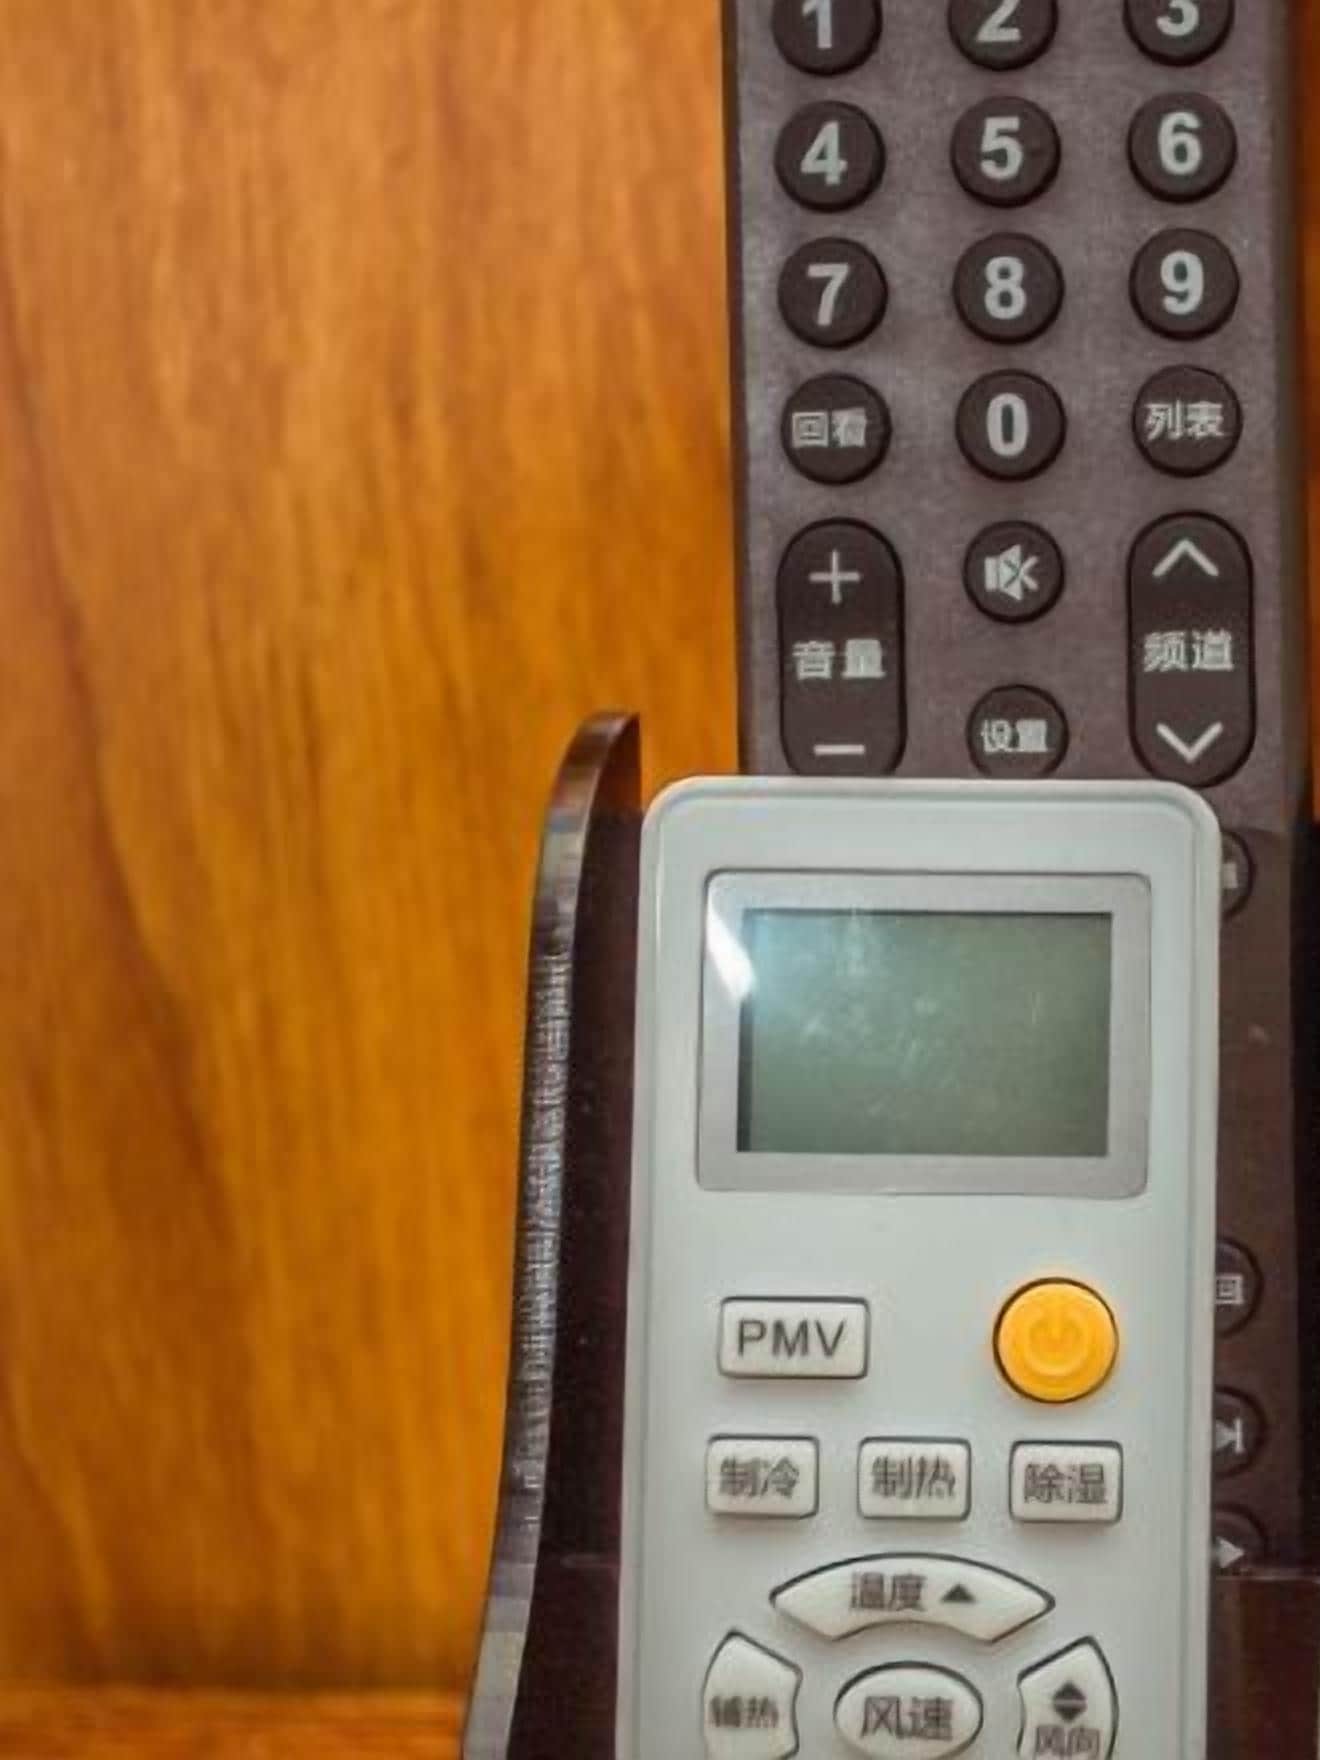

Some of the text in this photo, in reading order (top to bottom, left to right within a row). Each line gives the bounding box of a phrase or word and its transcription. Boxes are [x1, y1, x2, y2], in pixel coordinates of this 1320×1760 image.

[802, 0, 833, 49] 1
[976, 0, 1021, 42] 2
[1156, 0, 1198, 37] 3
[801, 121, 847, 185] 4
[980, 117, 1023, 179] 5
[1158, 111, 1200, 175] 6
[808, 263, 849, 326] 7
[984, 257, 1026, 319] 8
[1160, 250, 1203, 314] 9
[791, 408, 867, 449] 回看
[986, 393, 1029, 456] 0
[1145, 400, 1225, 441] 列表
[792, 639, 885, 680] 音量
[1143, 630, 1234, 673] 频道
[981, 719, 1048, 753] 设置
[738, 1319, 846, 1359] PMV
[719, 1456, 800, 1500] 制冷
[871, 1456, 956, 1500] 制热
[1024, 1463, 1107, 1505] 除湿
[849, 1571, 926, 1612] 温度
[860, 1695, 953, 1741] 风速
[1033, 1724, 1100, 1759] 风向
